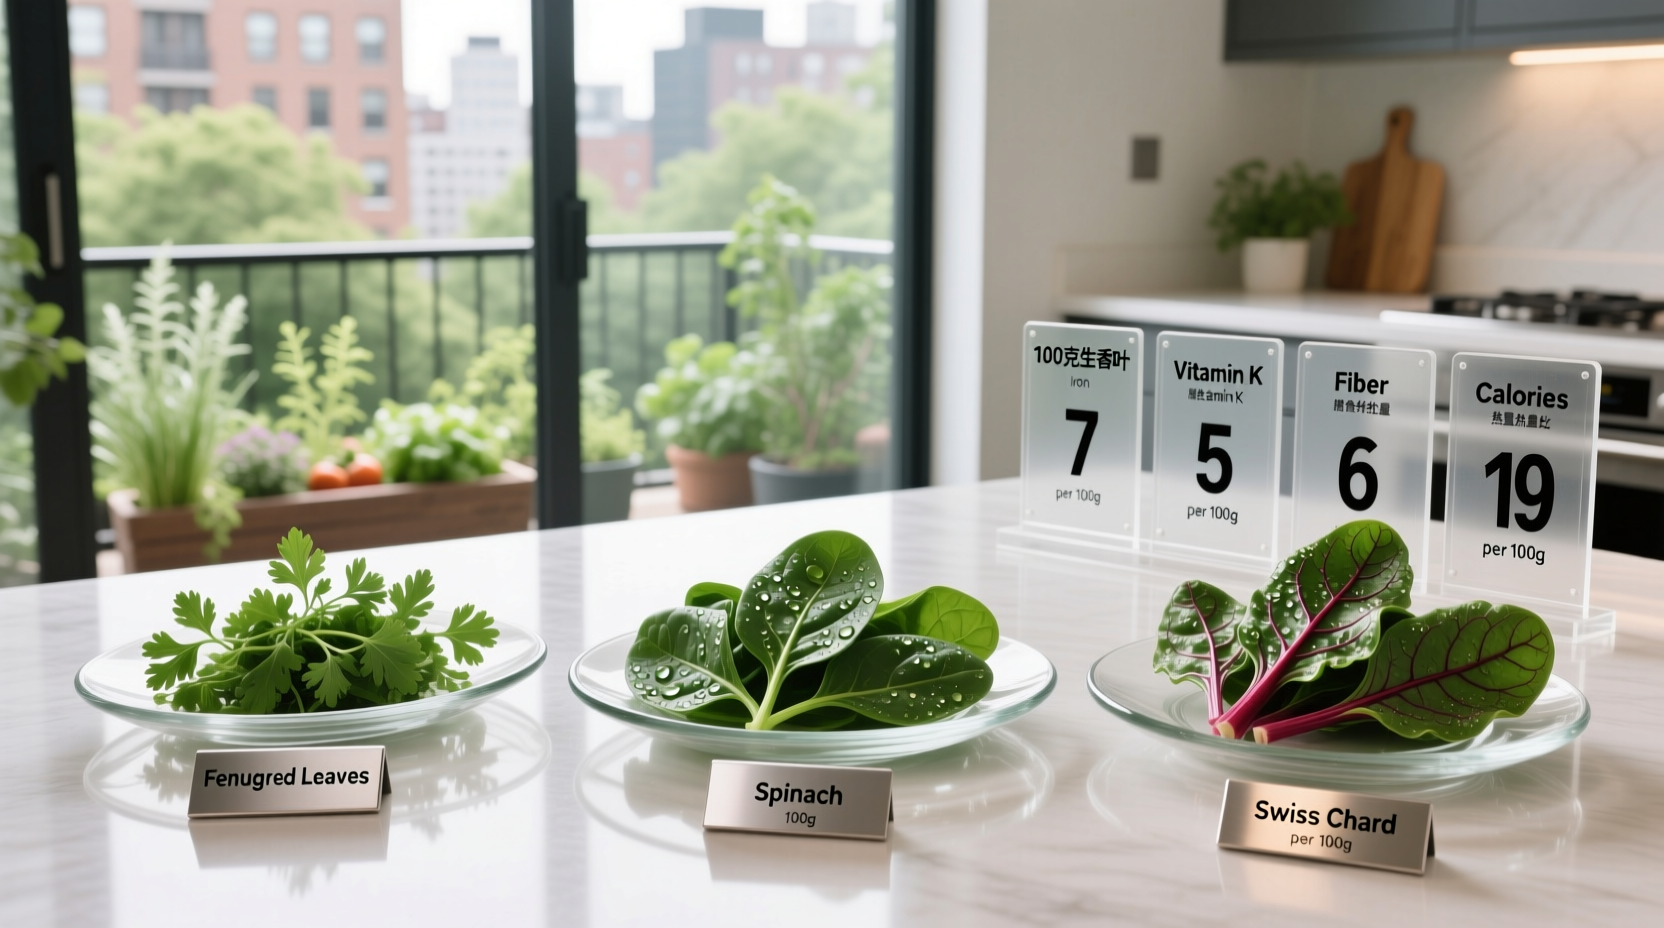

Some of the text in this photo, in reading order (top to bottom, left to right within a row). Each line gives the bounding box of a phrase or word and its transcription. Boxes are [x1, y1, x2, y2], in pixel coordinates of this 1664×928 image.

[1070, 375, 1090, 388] Iron
[1174, 360, 1264, 385] Vitamin K
[1335, 371, 1389, 395] Fiber
[1235, 391, 1244, 404] K
[1476, 382, 1569, 409] Calories
[1065, 408, 1099, 476] 7
[1196, 422, 1233, 494] 5
[1338, 436, 1379, 512] 6
[1056, 489, 1101, 505] per 100g
[1484, 451, 1555, 532] 19
[1187, 506, 1238, 525] per 100g
[1482, 543, 1545, 565] per 100g
[204, 767, 370, 791] Fenugred Leaves
[754, 782, 843, 807] Spinach
[785, 812, 816, 828] 100g
[1254, 800, 1397, 835] Swiss Chard
[1291, 834, 1352, 853] per 100g
